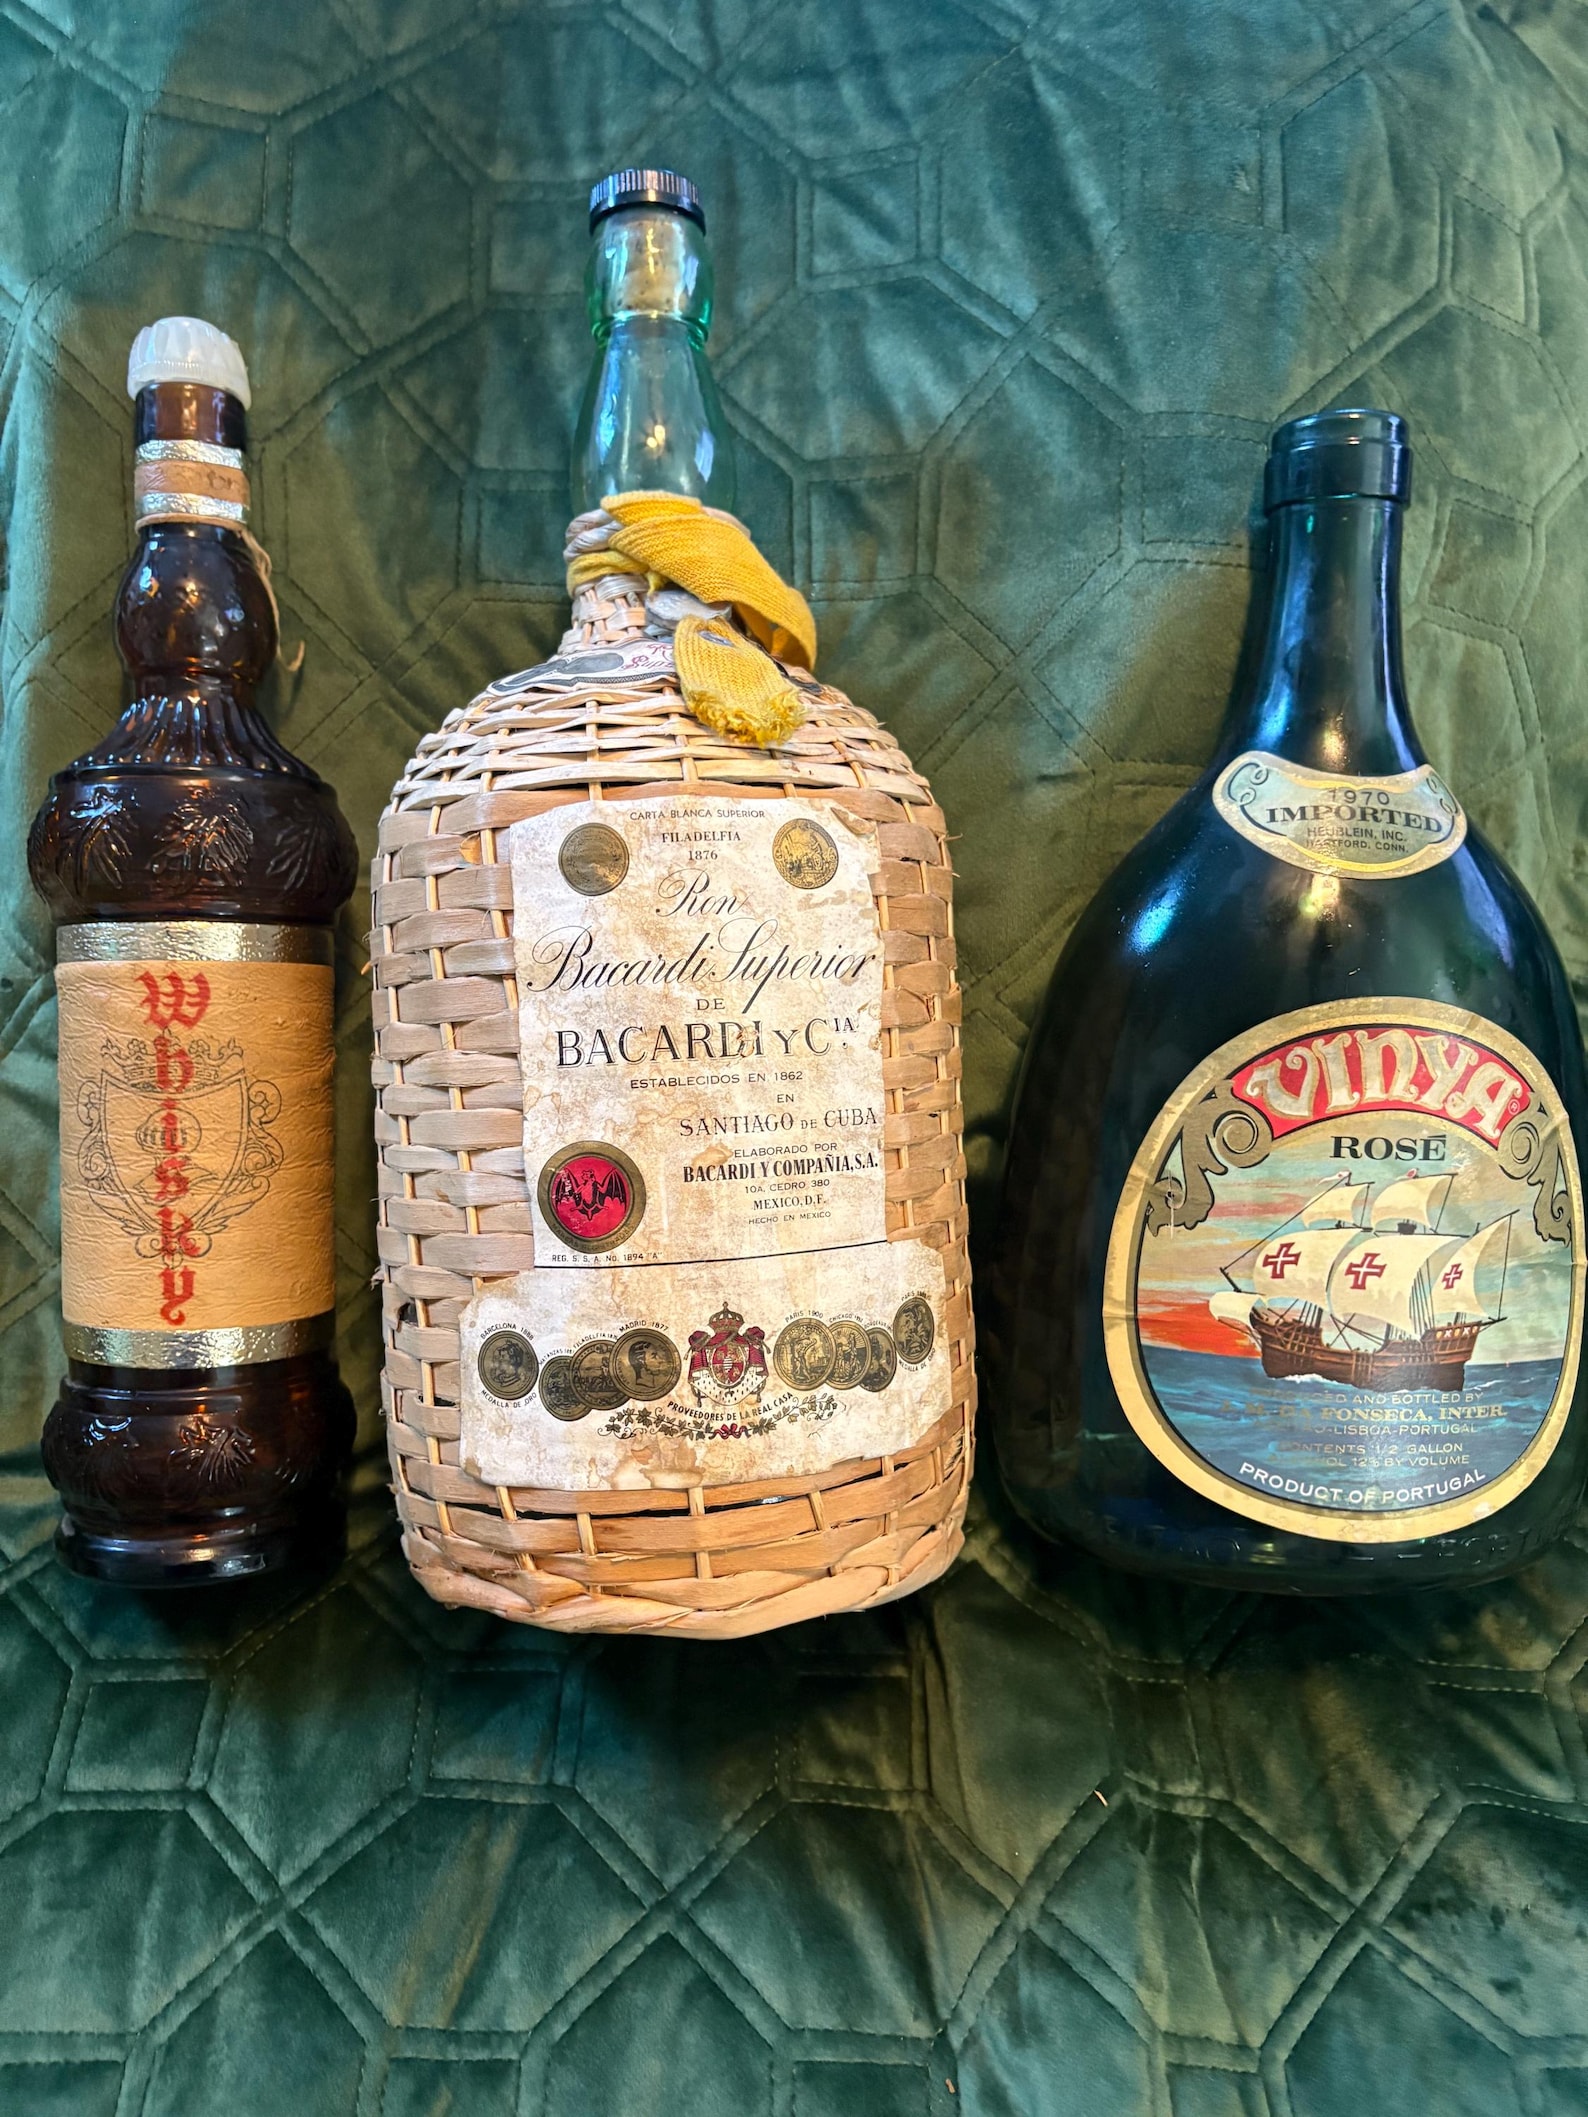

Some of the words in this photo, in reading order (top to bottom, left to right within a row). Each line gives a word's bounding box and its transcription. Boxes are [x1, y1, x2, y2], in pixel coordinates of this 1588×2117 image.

[1328, 788, 1390, 806] 1970
[630, 810, 666, 821] CARTA
[670, 809, 713, 819] BLANCA
[717, 809, 766, 819] SUPERIOR
[1266, 805, 1442, 833] IMPORTED
[661, 831, 742, 843] FILADELFIA
[1307, 827, 1377, 840] HEUBLEIN,
[1382, 830, 1408, 842] INC.
[688, 850, 719, 861] 1876
[1375, 842, 1409, 853] CONN.
[655, 868, 750, 918] Ron
[527, 925, 715, 993] Bacardi
[711, 917, 876, 1014] Superior
[696, 998, 726, 1012] DE
[556, 1021, 763, 1069] BACARDI
[630, 1074, 740, 1089] ESTABLECIDOS
[748, 1073, 767, 1083] EN
[774, 1070, 804, 1082] 1862
[777, 1093, 795, 1104] EN
[679, 1112, 795, 1137] SANTIAGO
[800, 1118, 818, 1130] DE
[823, 1107, 878, 1128] CUBA
[134, 970, 213, 1327] Whisky
[734, 1144, 808, 1158] ELABORADO
[814, 1142, 838, 1152] POR
[1329, 1134, 1447, 1162] ROSÉ
[683, 1163, 756, 1183] BACARDI
[760, 1161, 770, 1178] Y
[769, 1182, 806, 1192] CEDRO
[811, 1178, 831, 1188] 380
[748, 1216, 779, 1225] HECHO
[799, 1211, 832, 1220] MEXICO
[552, 1254, 569, 1262] REG.
[572, 1254, 579, 1262] S.
[583, 1255, 591, 1263] S.
[624, 1253, 644, 1261] 1894
[784, 1310, 804, 1323] PARIS
[808, 1309, 824, 1319] 1900
[829, 1313, 853, 1323] CHICAGO
[480, 1322, 517, 1340] BARCELONA
[619, 1320, 647, 1332] MADRID
[652, 1321, 669, 1332] 1877
[573, 1332, 606, 1349] FILADELFIA
[481, 1390, 510, 1409] MEDALLA
[667, 1400, 724, 1421] PROVEEDORES
[740, 1411, 751, 1420] LA
[752, 1404, 772, 1417] REAL
[773, 1391, 793, 1407] CASA
[1352, 1394, 1386, 1404] AND
[1391, 1393, 1461, 1404] BOTTLED
[1465, 1392, 1484, 1402] BY
[1321, 1406, 1434, 1422] FONSECA,
[1438, 1404, 1508, 1420] INTER.
[1373, 1444, 1399, 1455] 1/2
[1407, 1442, 1463, 1455] GALLON
[1384, 1457, 1405, 1467] BY
[1408, 1454, 1470, 1466] VOLUME
[1239, 1461, 1344, 1503] PRODUCT
[1349, 1490, 1376, 1504] OF
[1381, 1467, 1486, 1504] PORTUGAL
